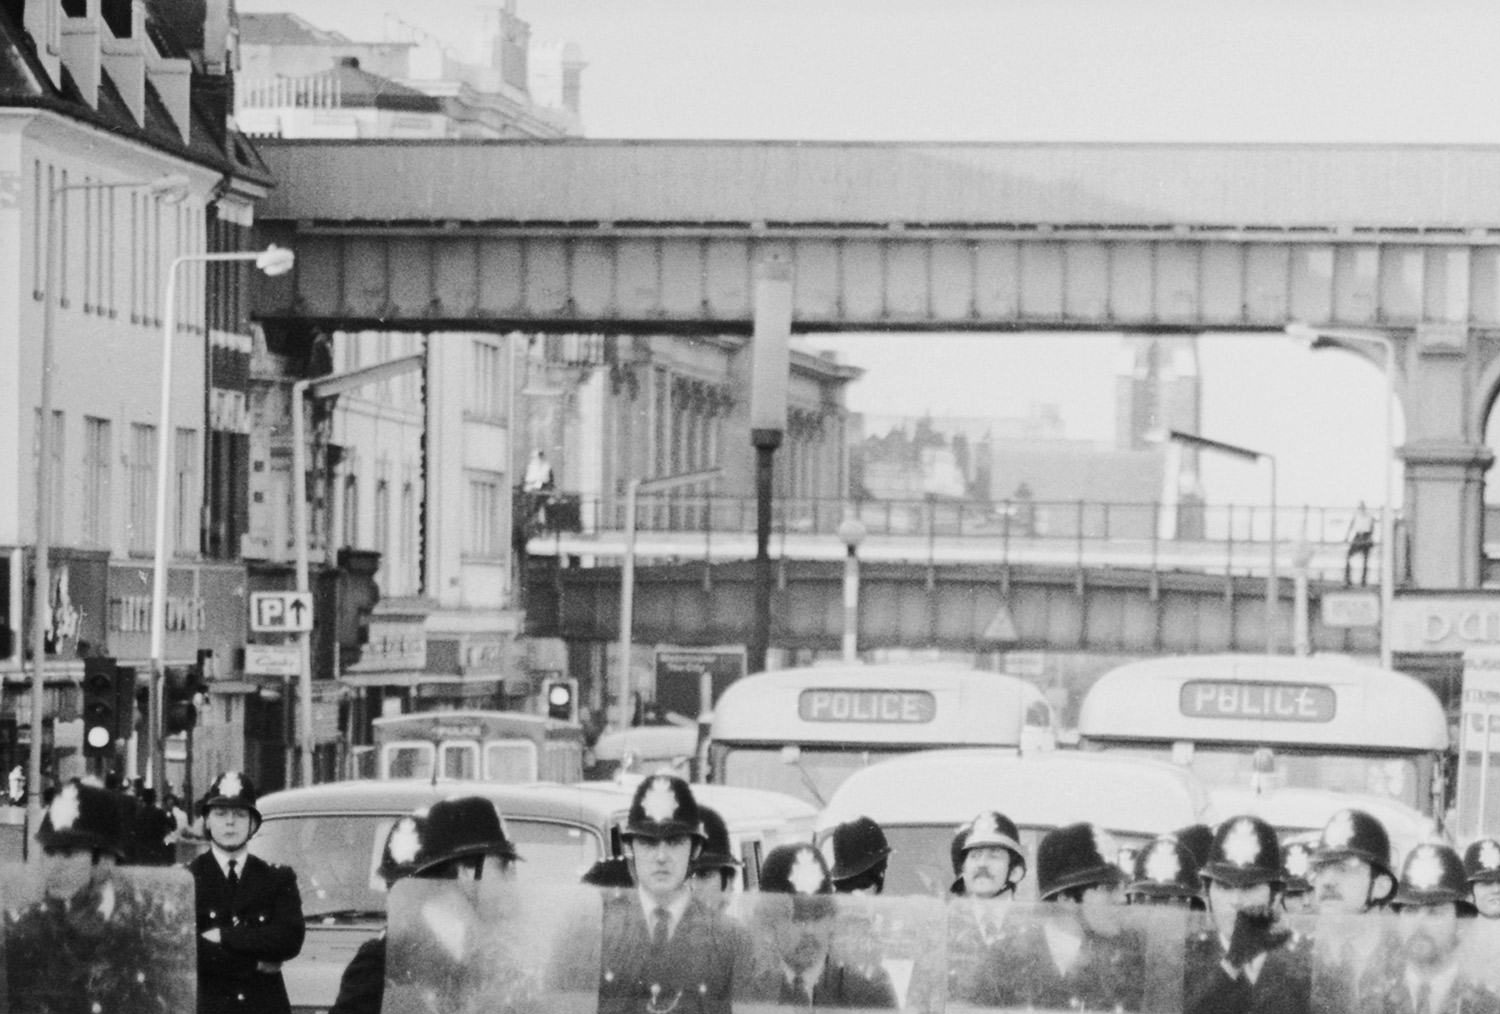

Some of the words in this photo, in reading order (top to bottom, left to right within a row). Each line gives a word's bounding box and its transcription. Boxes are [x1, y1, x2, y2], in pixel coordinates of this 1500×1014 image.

[259, 600, 284, 626] P
[811, 693, 921, 720] POLICE
[1196, 685, 1318, 717] POLICE
